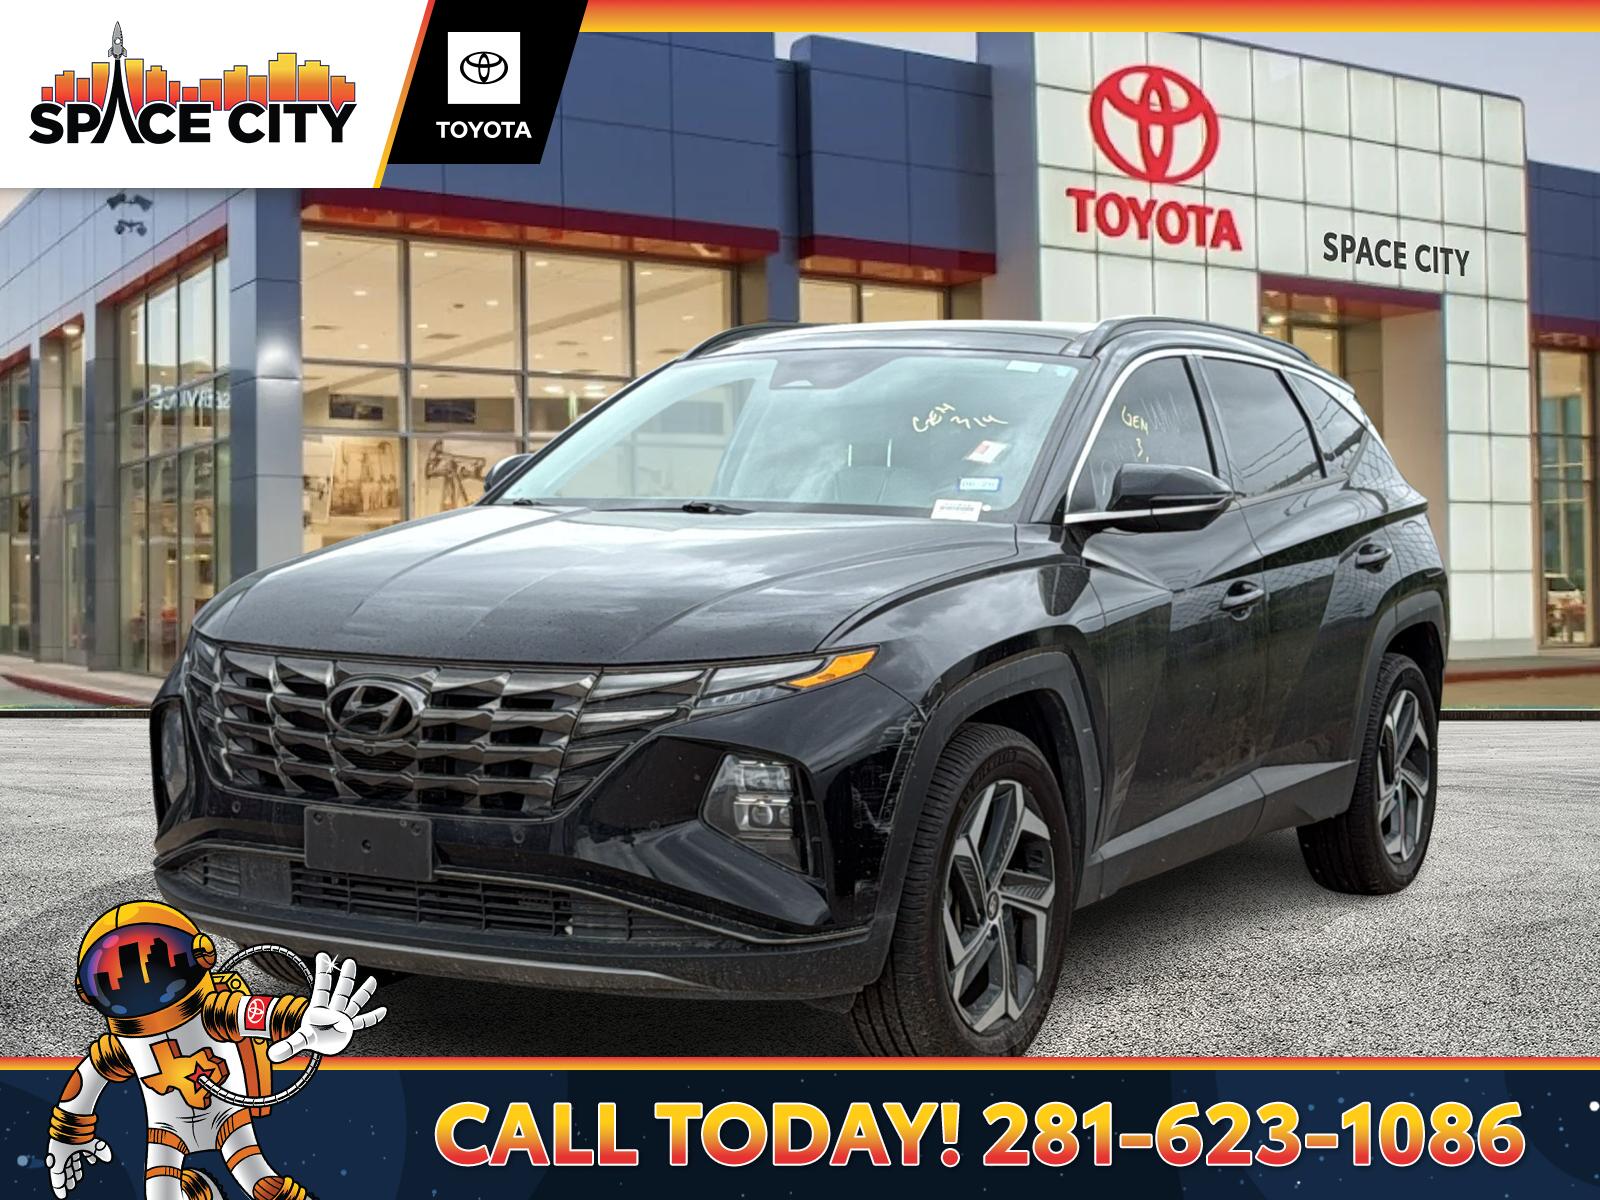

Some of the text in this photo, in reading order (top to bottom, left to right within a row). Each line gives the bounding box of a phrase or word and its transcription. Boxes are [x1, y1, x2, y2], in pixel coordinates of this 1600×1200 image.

[1066, 187, 1243, 251] TOYOTA
[1323, 232, 1470, 277] SPACE CITY
